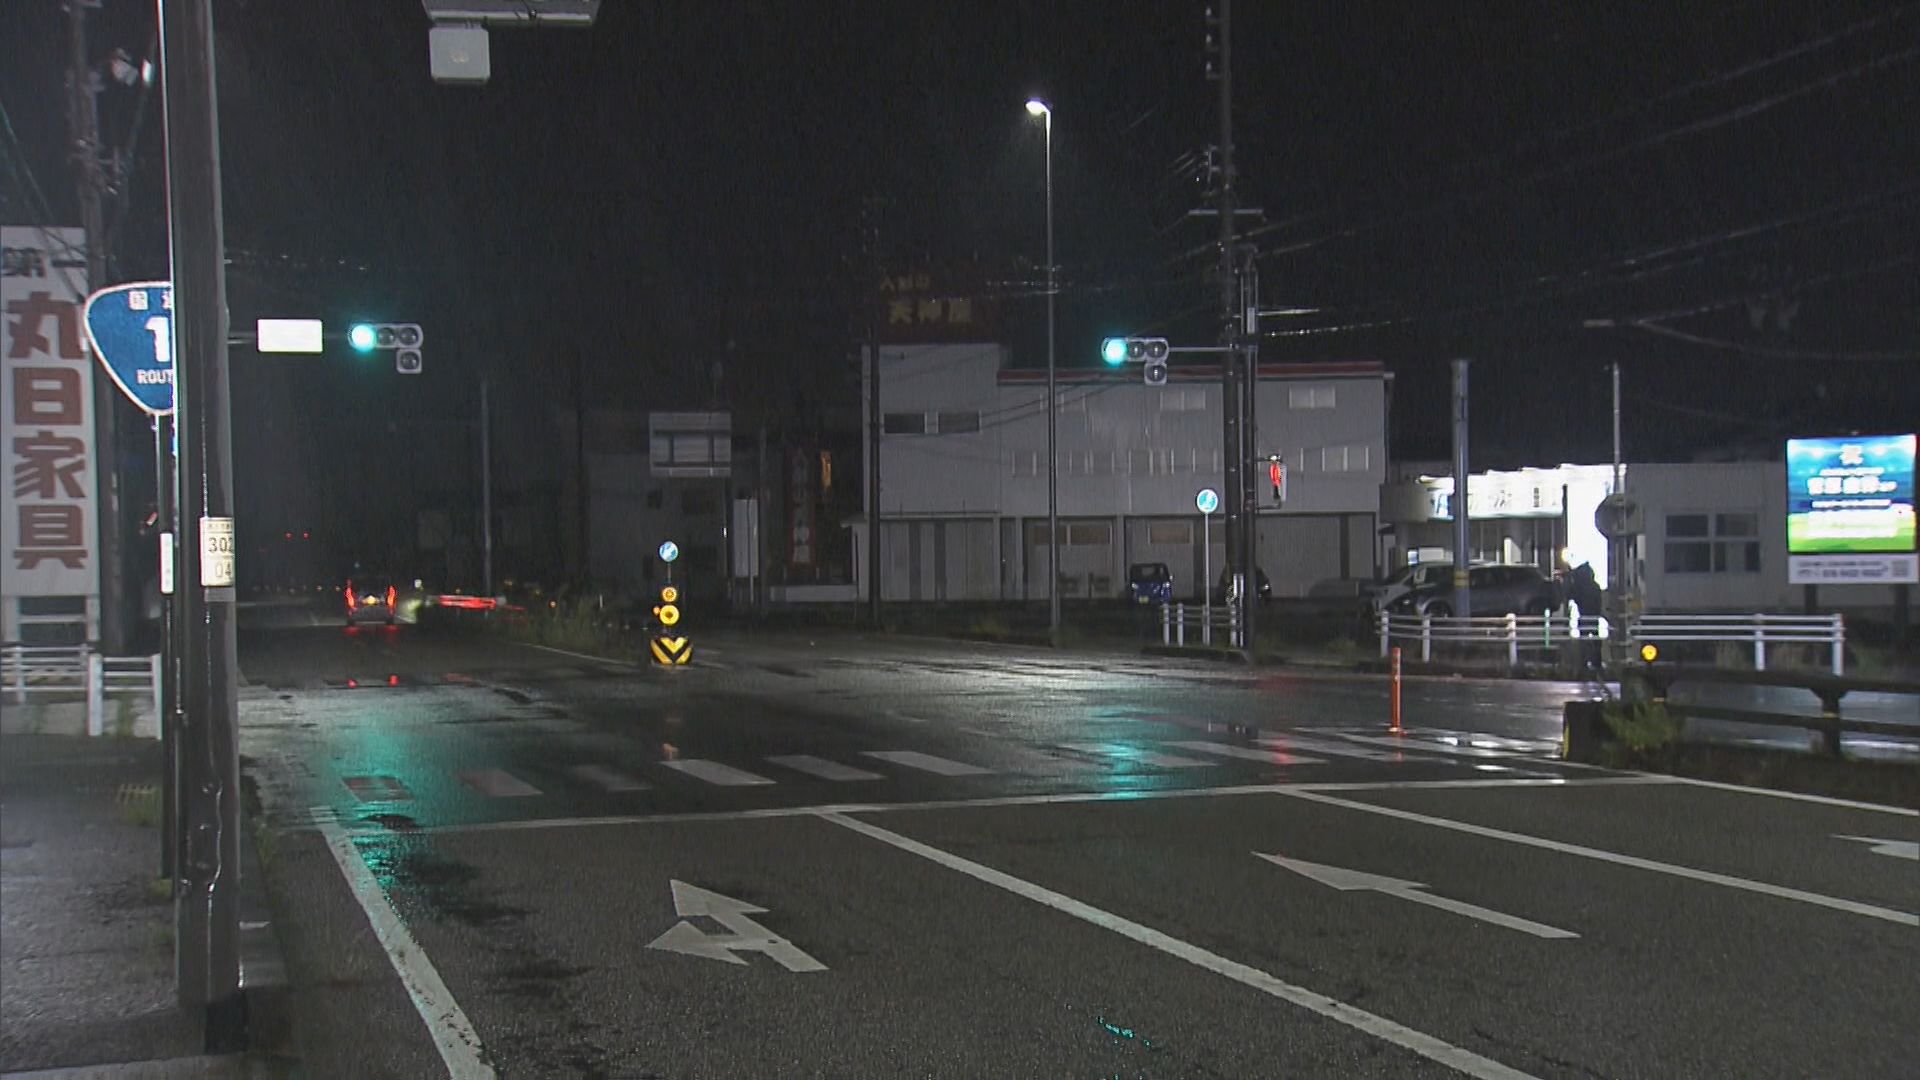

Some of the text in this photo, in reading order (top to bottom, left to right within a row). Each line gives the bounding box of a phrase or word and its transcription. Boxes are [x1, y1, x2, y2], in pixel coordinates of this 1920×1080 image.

[9, 291, 88, 569] 丸日家具
[137, 369, 173, 384] ROUT
